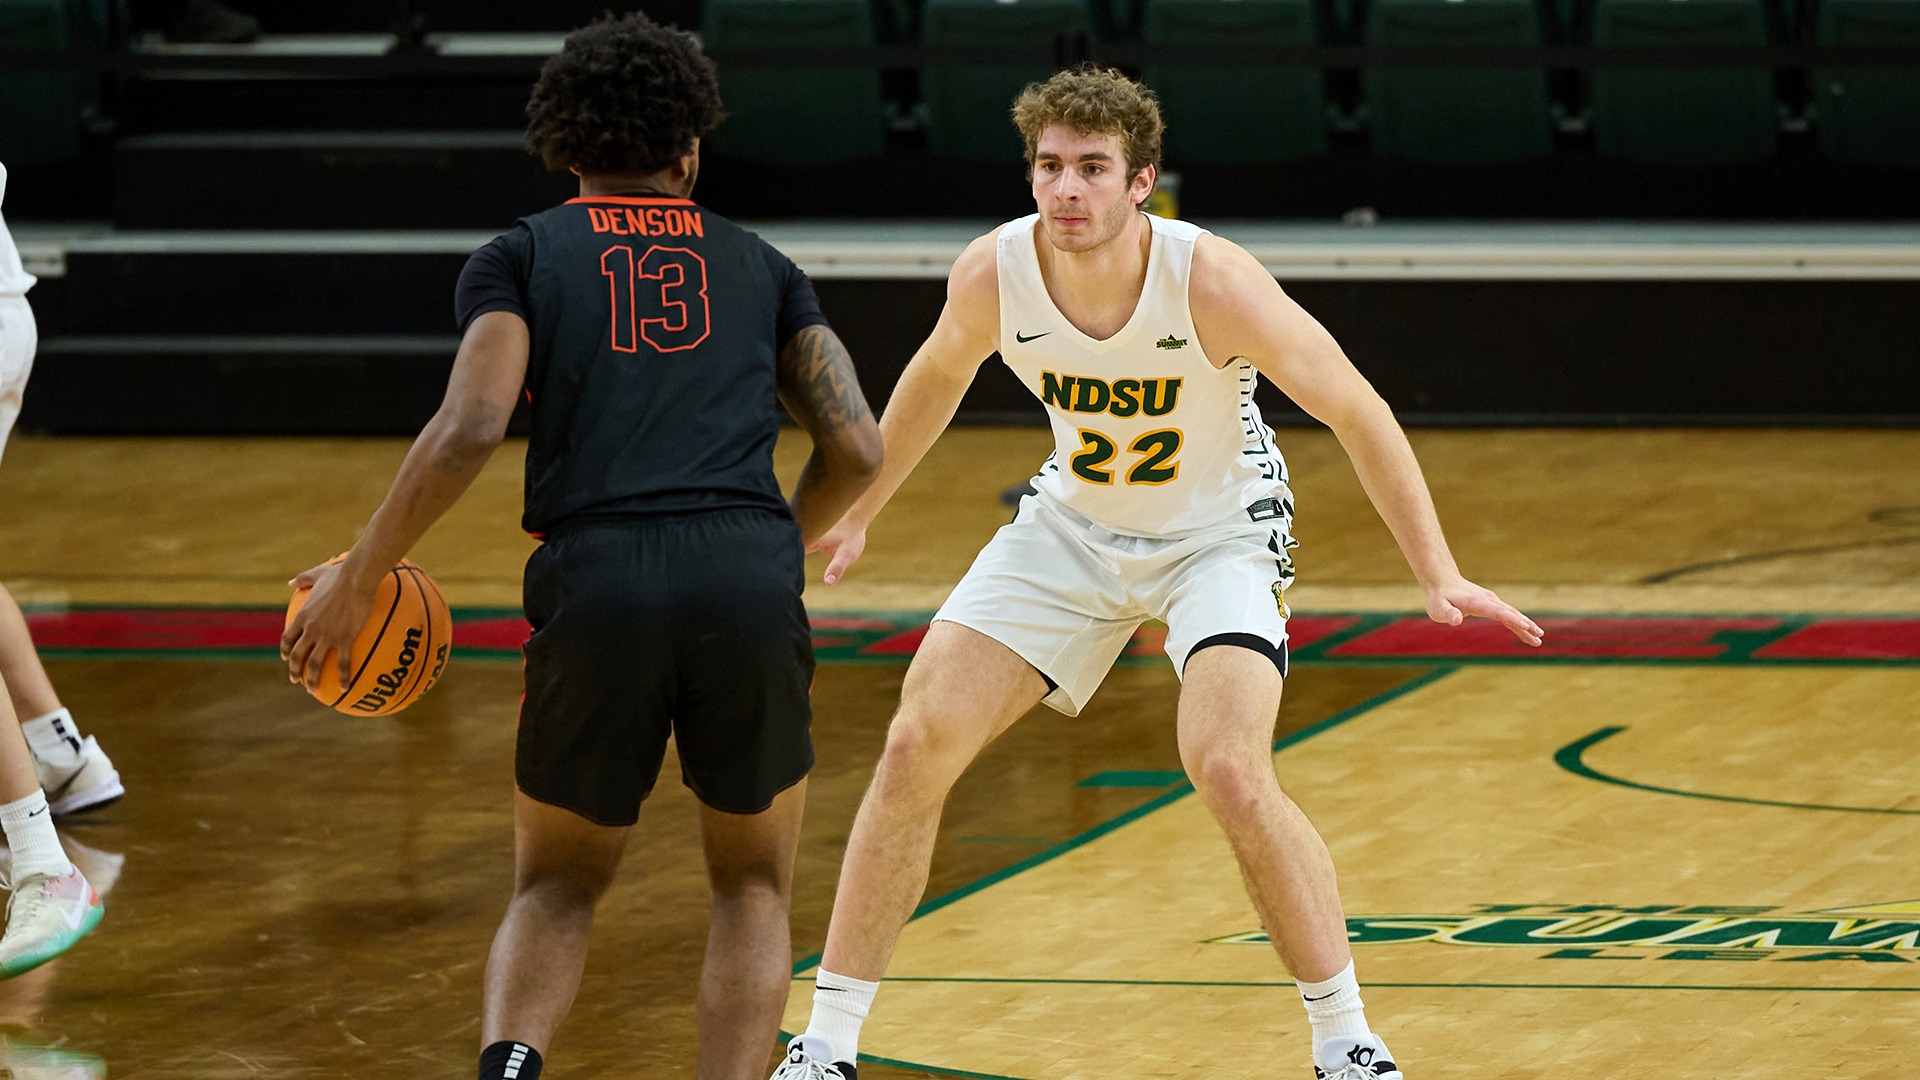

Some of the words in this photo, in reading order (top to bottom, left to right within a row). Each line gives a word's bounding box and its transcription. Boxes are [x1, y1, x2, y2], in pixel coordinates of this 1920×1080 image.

[587, 207, 704, 238] DENSON
[600, 245, 711, 353] 13
[1040, 369, 1184, 419] NDSU
[1069, 427, 1184, 486] 22
[351, 627, 422, 712] Wilson
[1470, 904, 1783, 915] THE
[1537, 949, 1920, 963] LEA
